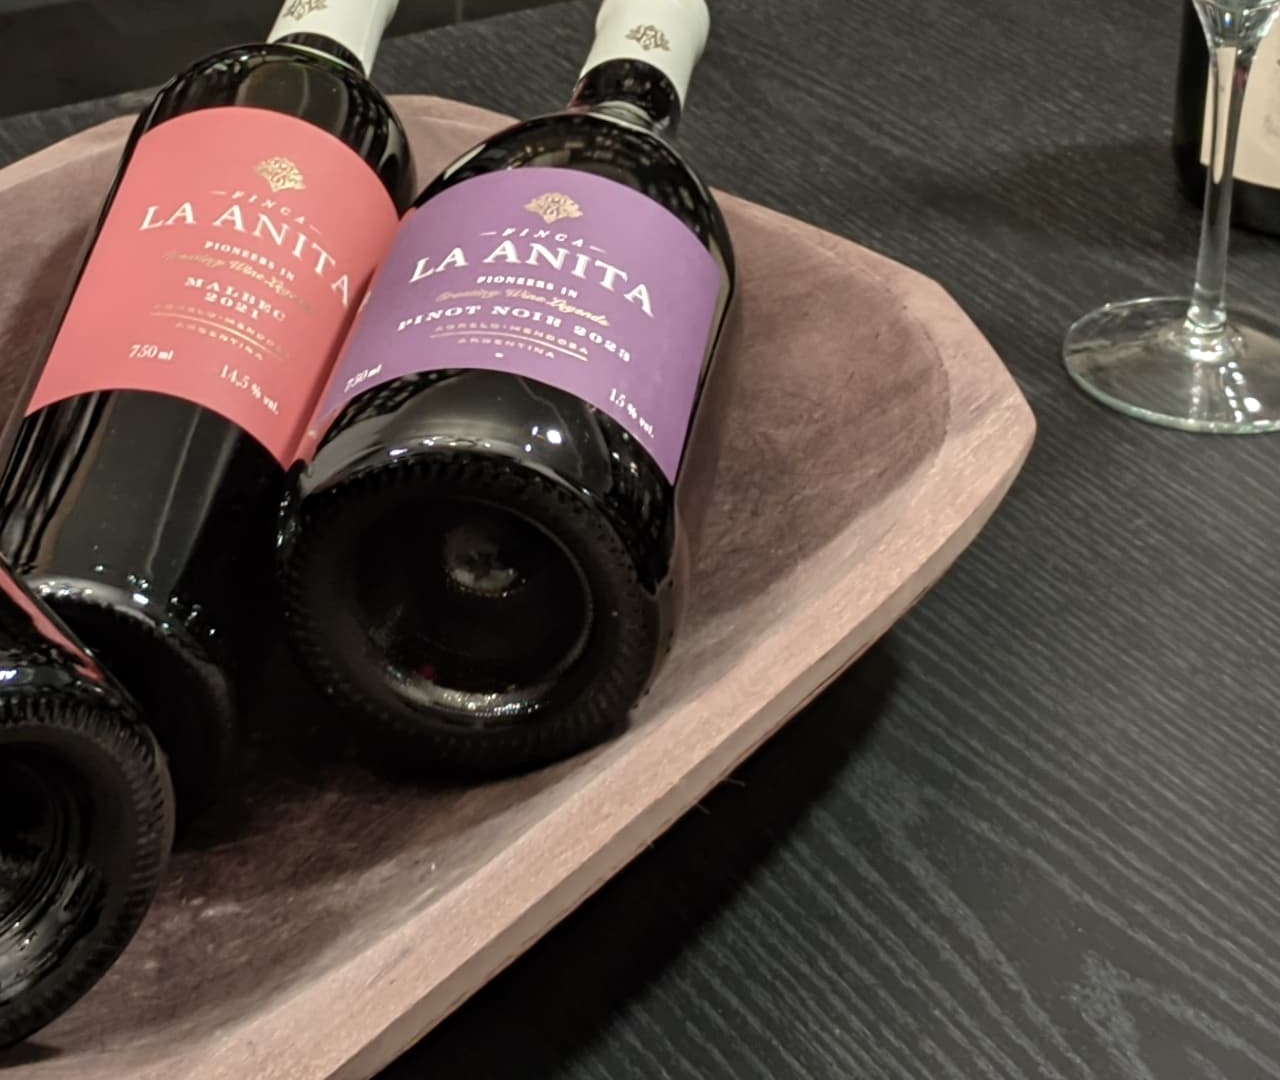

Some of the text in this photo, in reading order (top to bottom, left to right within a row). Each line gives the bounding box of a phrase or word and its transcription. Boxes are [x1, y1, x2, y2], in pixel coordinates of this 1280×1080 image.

[232, 190, 306, 225] FINCA
[502, 227, 584, 248] FINCA
[139, 201, 350, 309] LA ANITA
[204, 240, 296, 281] PIONEERS IN
[409, 239, 655, 318] LA ANITA
[477, 275, 579, 299] PIONEERS IN
[184, 276, 286, 322] MALBEC
[204, 292, 260, 320] 2021
[505, 288, 547, 305] Wine
[397, 304, 481, 332] PINOT
[491, 306, 562, 328] NOIR
[128, 344, 158, 358] 750
[457, 337, 555, 359] ARGENTINA
[251, 383, 262, 399] %
